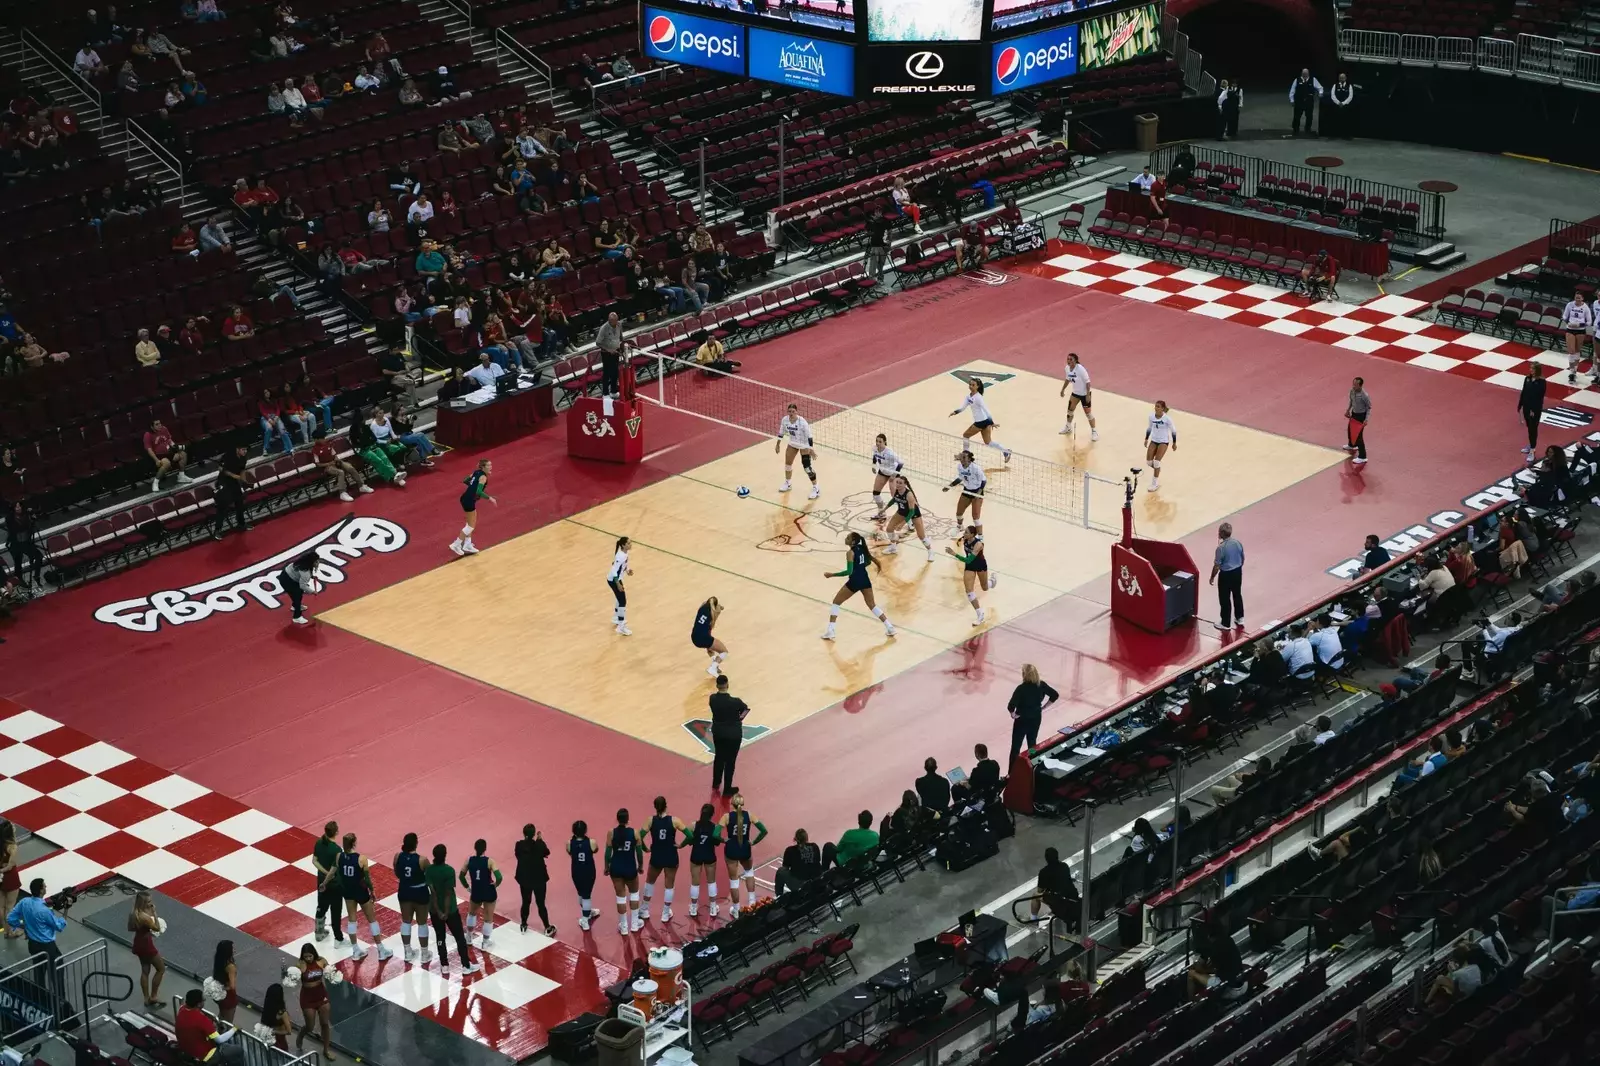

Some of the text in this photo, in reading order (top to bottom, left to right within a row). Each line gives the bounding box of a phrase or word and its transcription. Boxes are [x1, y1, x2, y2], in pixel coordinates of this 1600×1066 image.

[681, 31, 738, 58] pepsi
[779, 47, 826, 77] AQUAFINA
[1024, 37, 1072, 76] pepsi
[873, 84, 976, 94] FRESNO LEXUS
[698, 614, 707, 625] 5
[700, 834, 708, 845] 7
[578, 853, 586, 862] 9
[343, 865, 354, 878] 10
[404, 867, 411, 878] 3
[475, 870, 481, 881] 1
